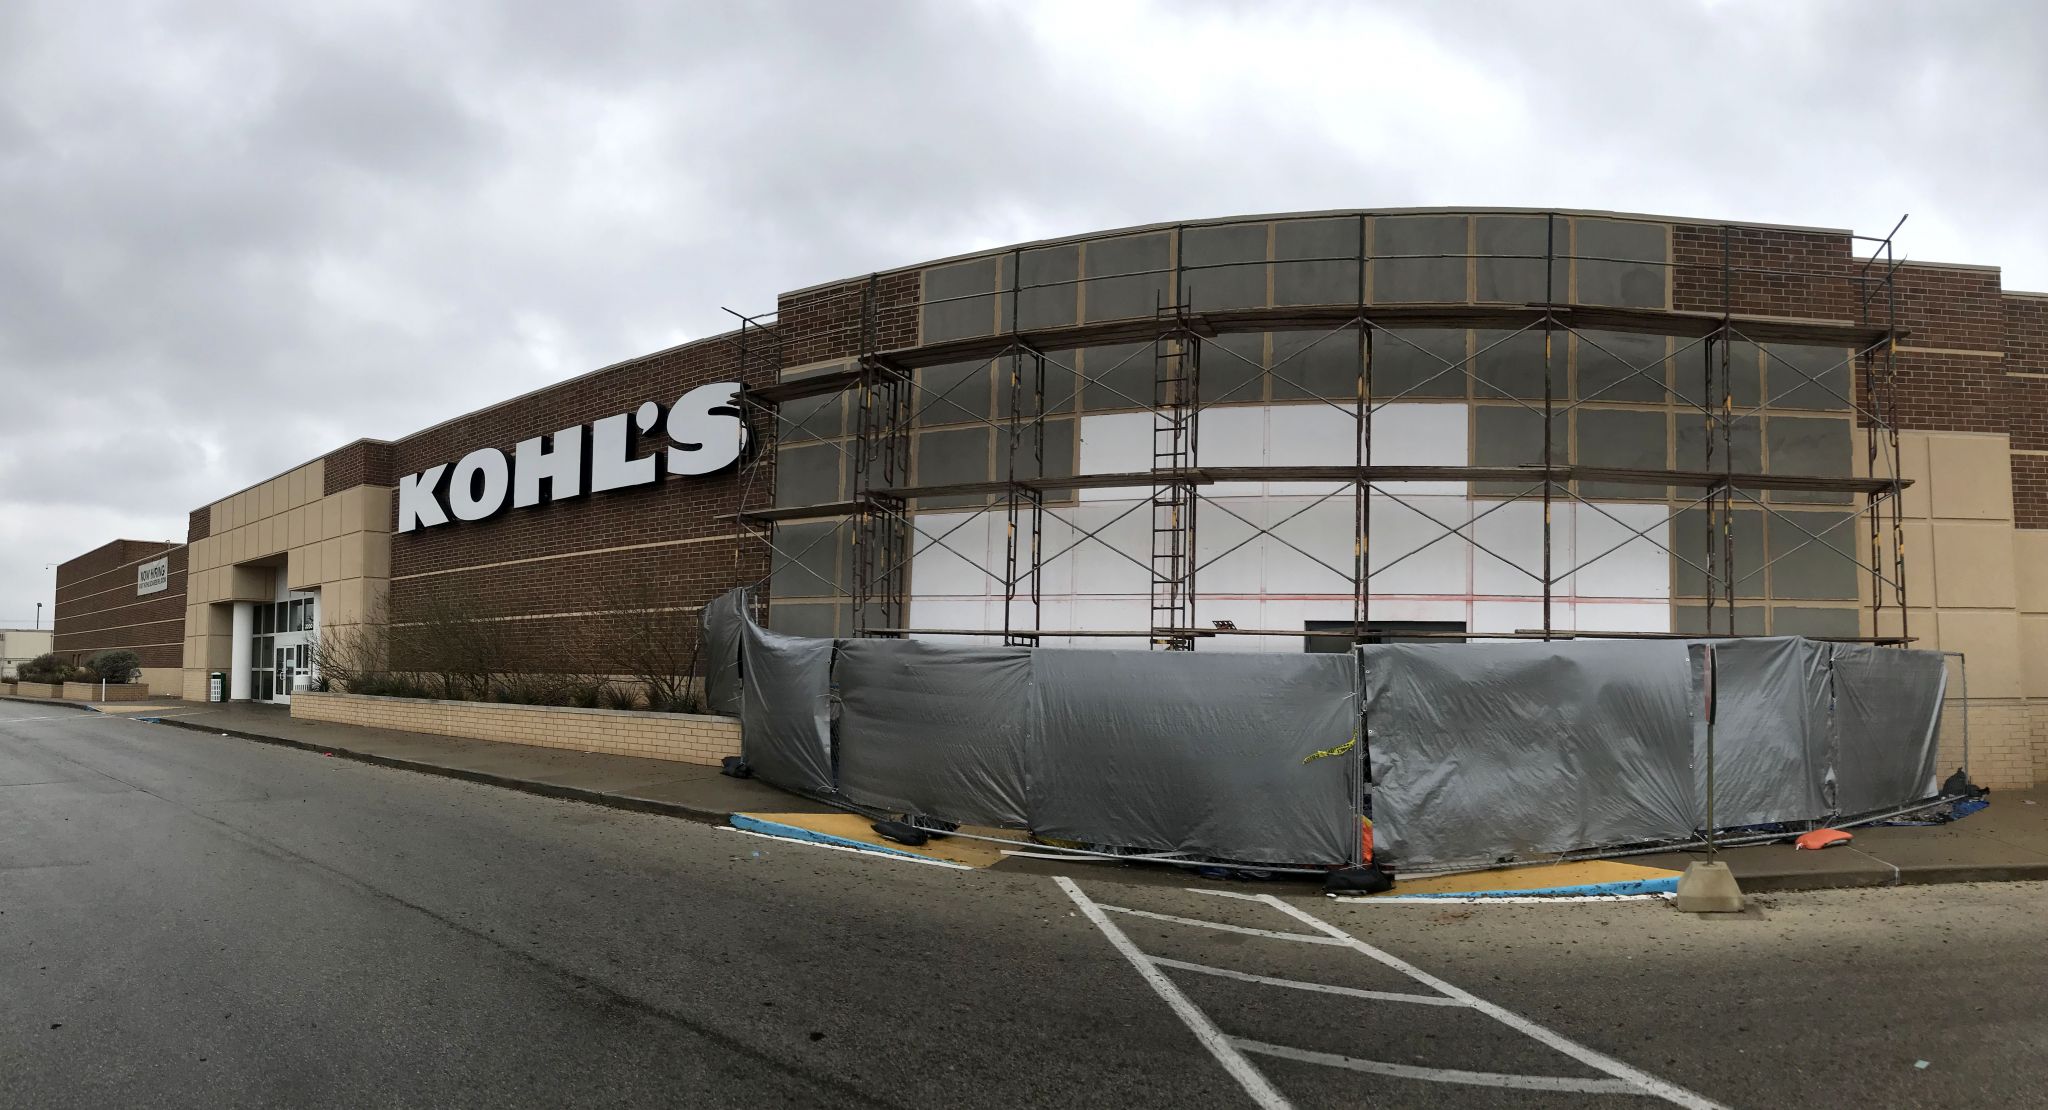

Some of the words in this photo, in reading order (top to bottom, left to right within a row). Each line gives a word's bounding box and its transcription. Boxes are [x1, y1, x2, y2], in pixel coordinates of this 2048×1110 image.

[398, 381, 748, 534] KOHL'S
[140, 569, 150, 582] NOW
[150, 564, 166, 580] HIRING
